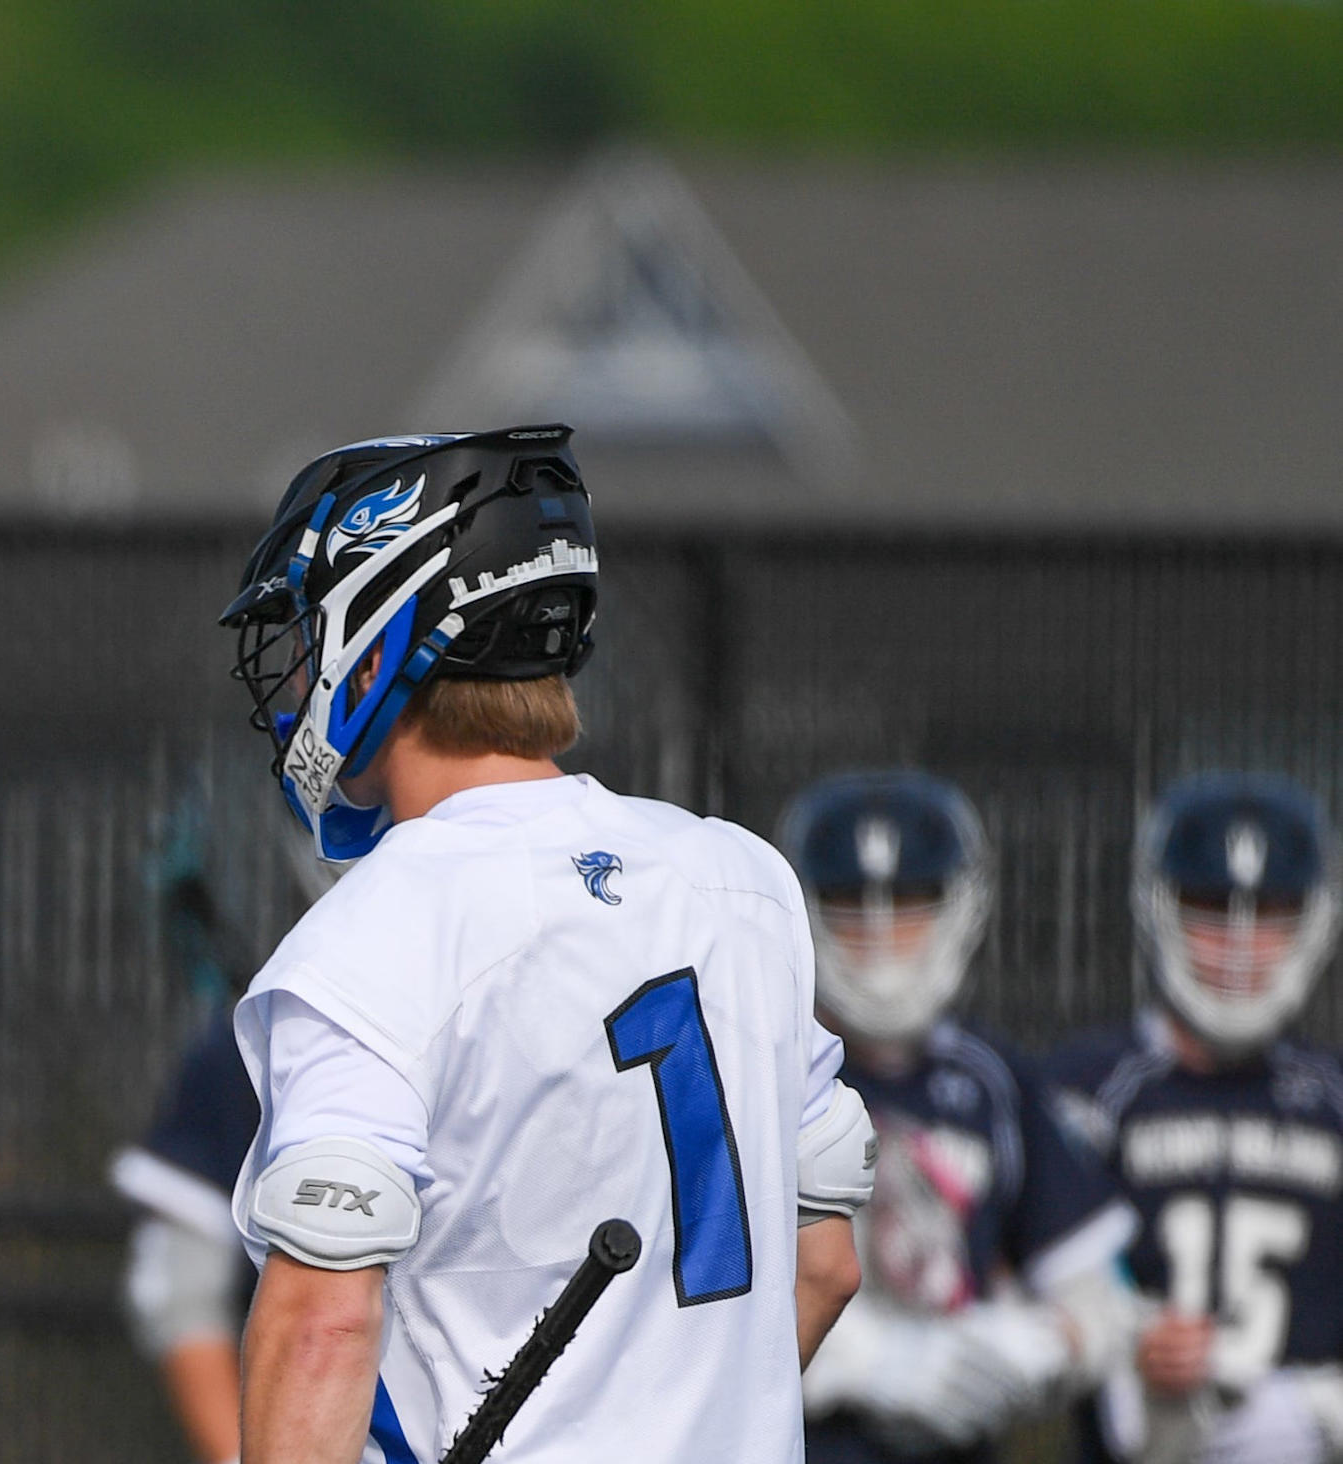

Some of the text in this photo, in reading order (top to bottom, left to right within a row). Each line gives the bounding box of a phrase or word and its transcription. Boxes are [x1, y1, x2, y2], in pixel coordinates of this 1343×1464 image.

[288, 727, 315, 784] NO
[292, 1178, 381, 1217] STX
[604, 966, 753, 1309] 1
[1161, 1193, 1307, 1390] 15
